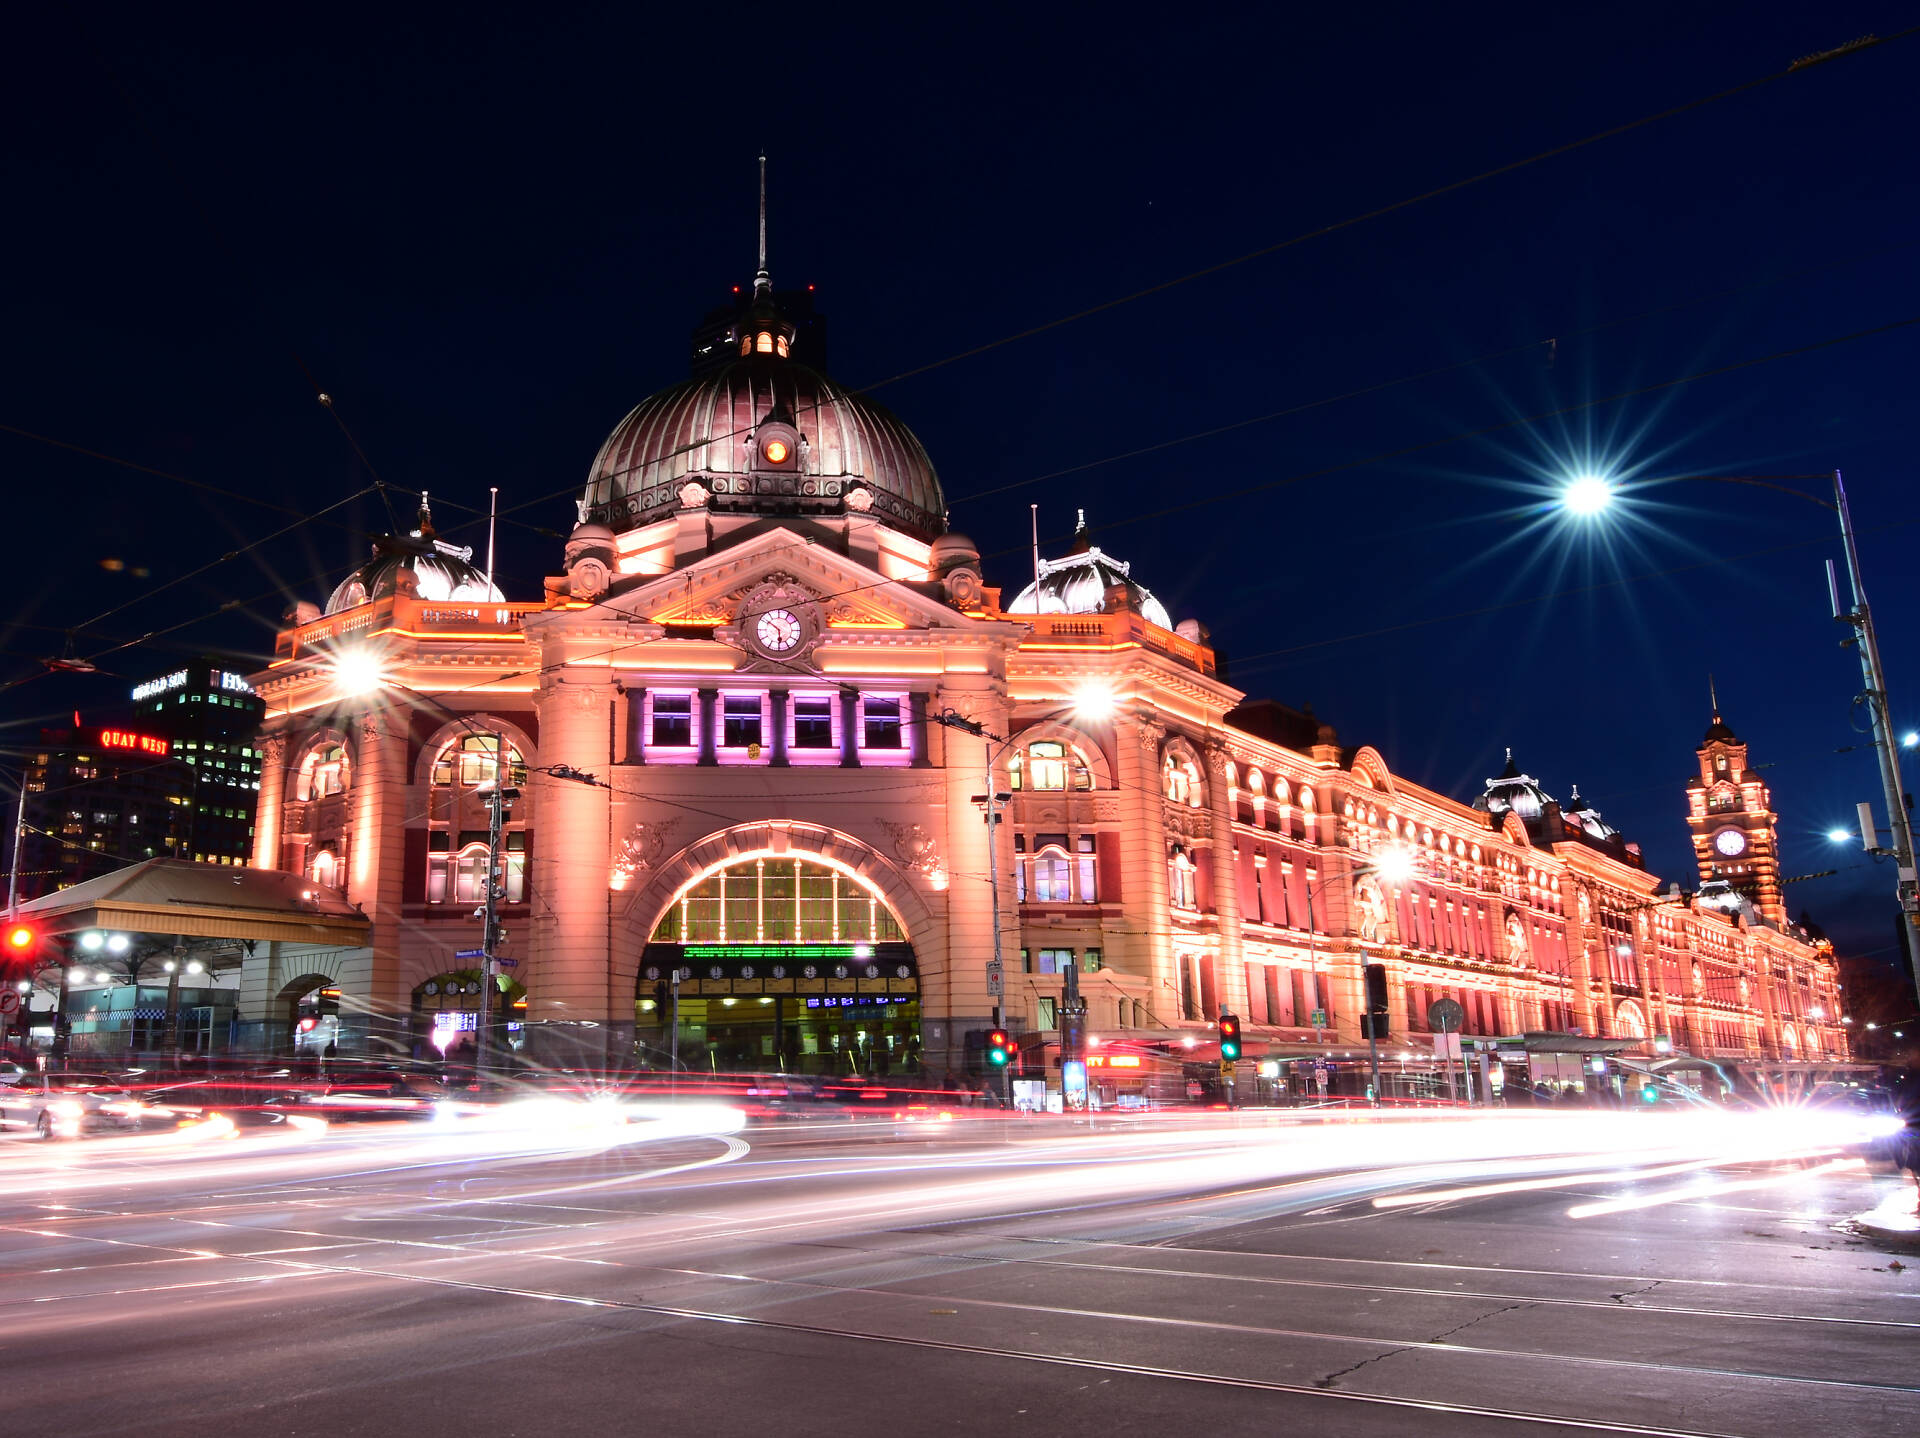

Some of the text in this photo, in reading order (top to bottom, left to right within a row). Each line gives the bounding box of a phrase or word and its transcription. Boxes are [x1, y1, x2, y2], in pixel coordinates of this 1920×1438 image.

[168, 671, 188, 688] SUN
[102, 731, 167, 754] QUAY WEST
